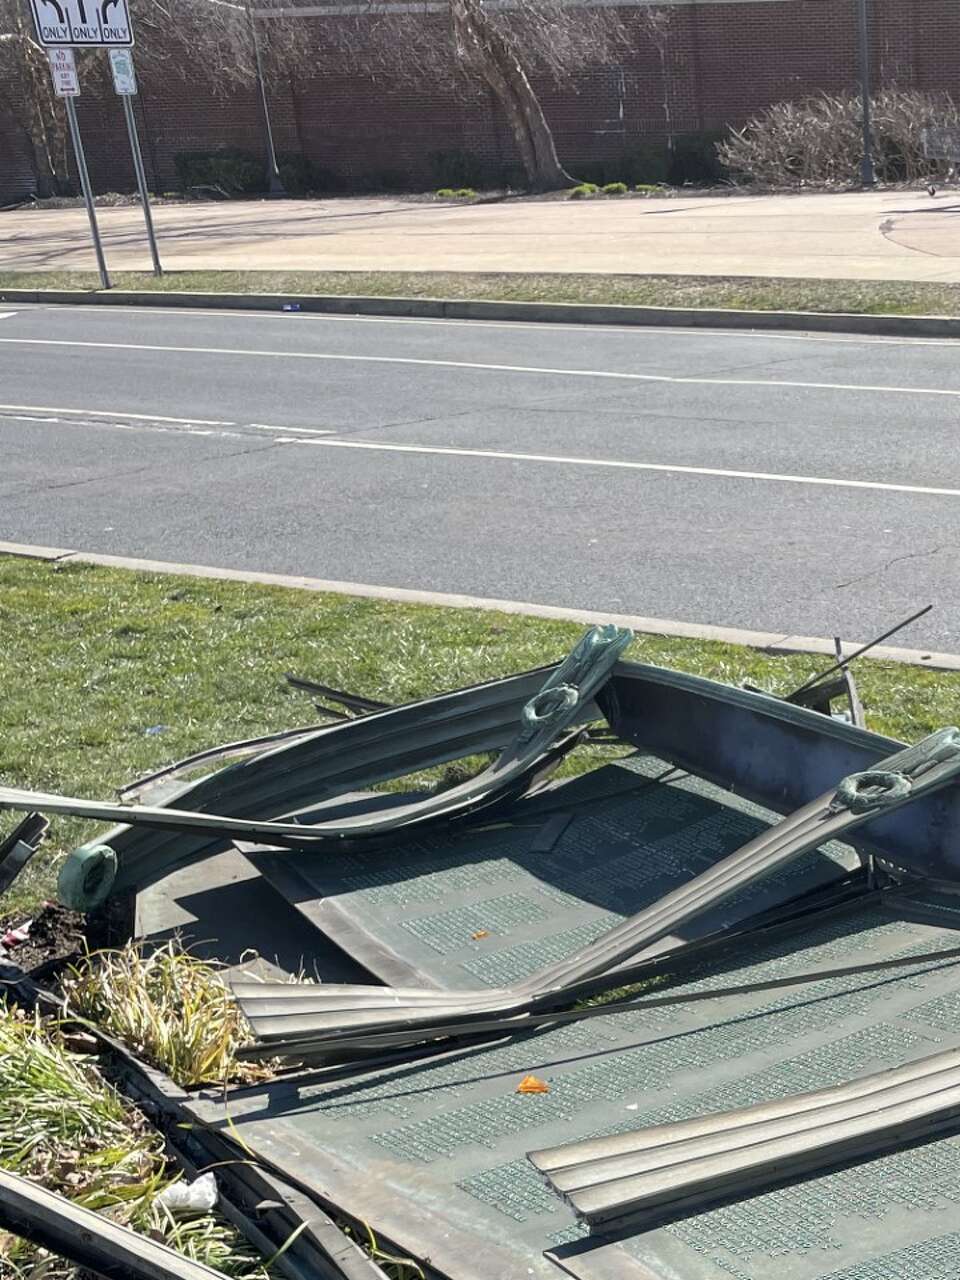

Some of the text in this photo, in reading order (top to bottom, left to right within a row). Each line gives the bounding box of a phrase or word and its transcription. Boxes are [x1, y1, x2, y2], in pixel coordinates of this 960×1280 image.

[43, 27, 68, 39] ONLY
[73, 27, 98, 39] ONLY
[103, 28, 127, 39] ONLY
